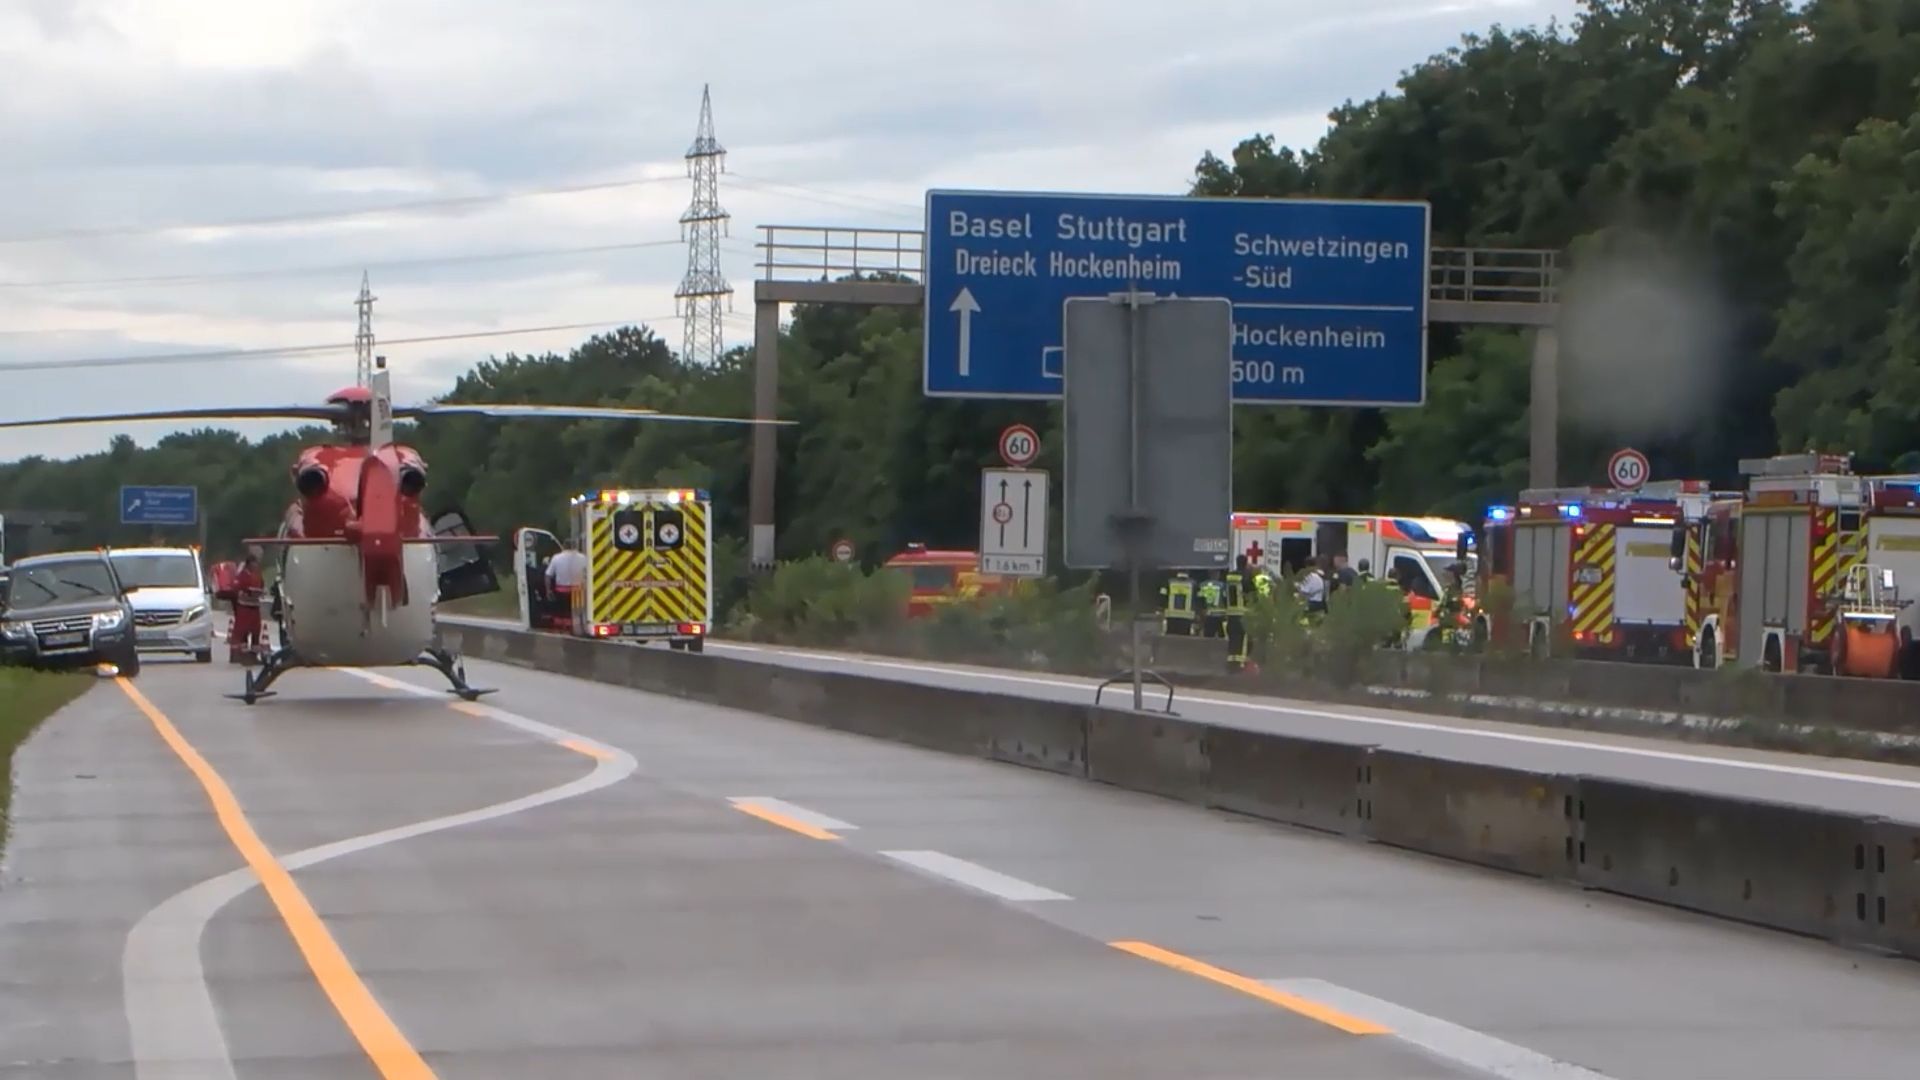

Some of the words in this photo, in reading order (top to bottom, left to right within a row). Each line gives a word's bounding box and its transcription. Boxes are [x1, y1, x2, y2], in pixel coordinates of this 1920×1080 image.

[950, 211, 1032, 238] Basel
[1057, 213, 1187, 248] Stuttgart
[1234, 233, 1409, 264] Schwetzingen
[956, 249, 1037, 277] Dreieck
[1050, 252, 1181, 280] Hockenheim
[1233, 265, 1292, 289] -Süd
[1232, 323, 1385, 348] Hockenheim
[1231, 360, 1275, 383] 500
[1282, 366, 1304, 384] m
[1010, 437, 1031, 455] 60
[1618, 461, 1640, 479] 60
[1012, 560, 1030, 571] km
